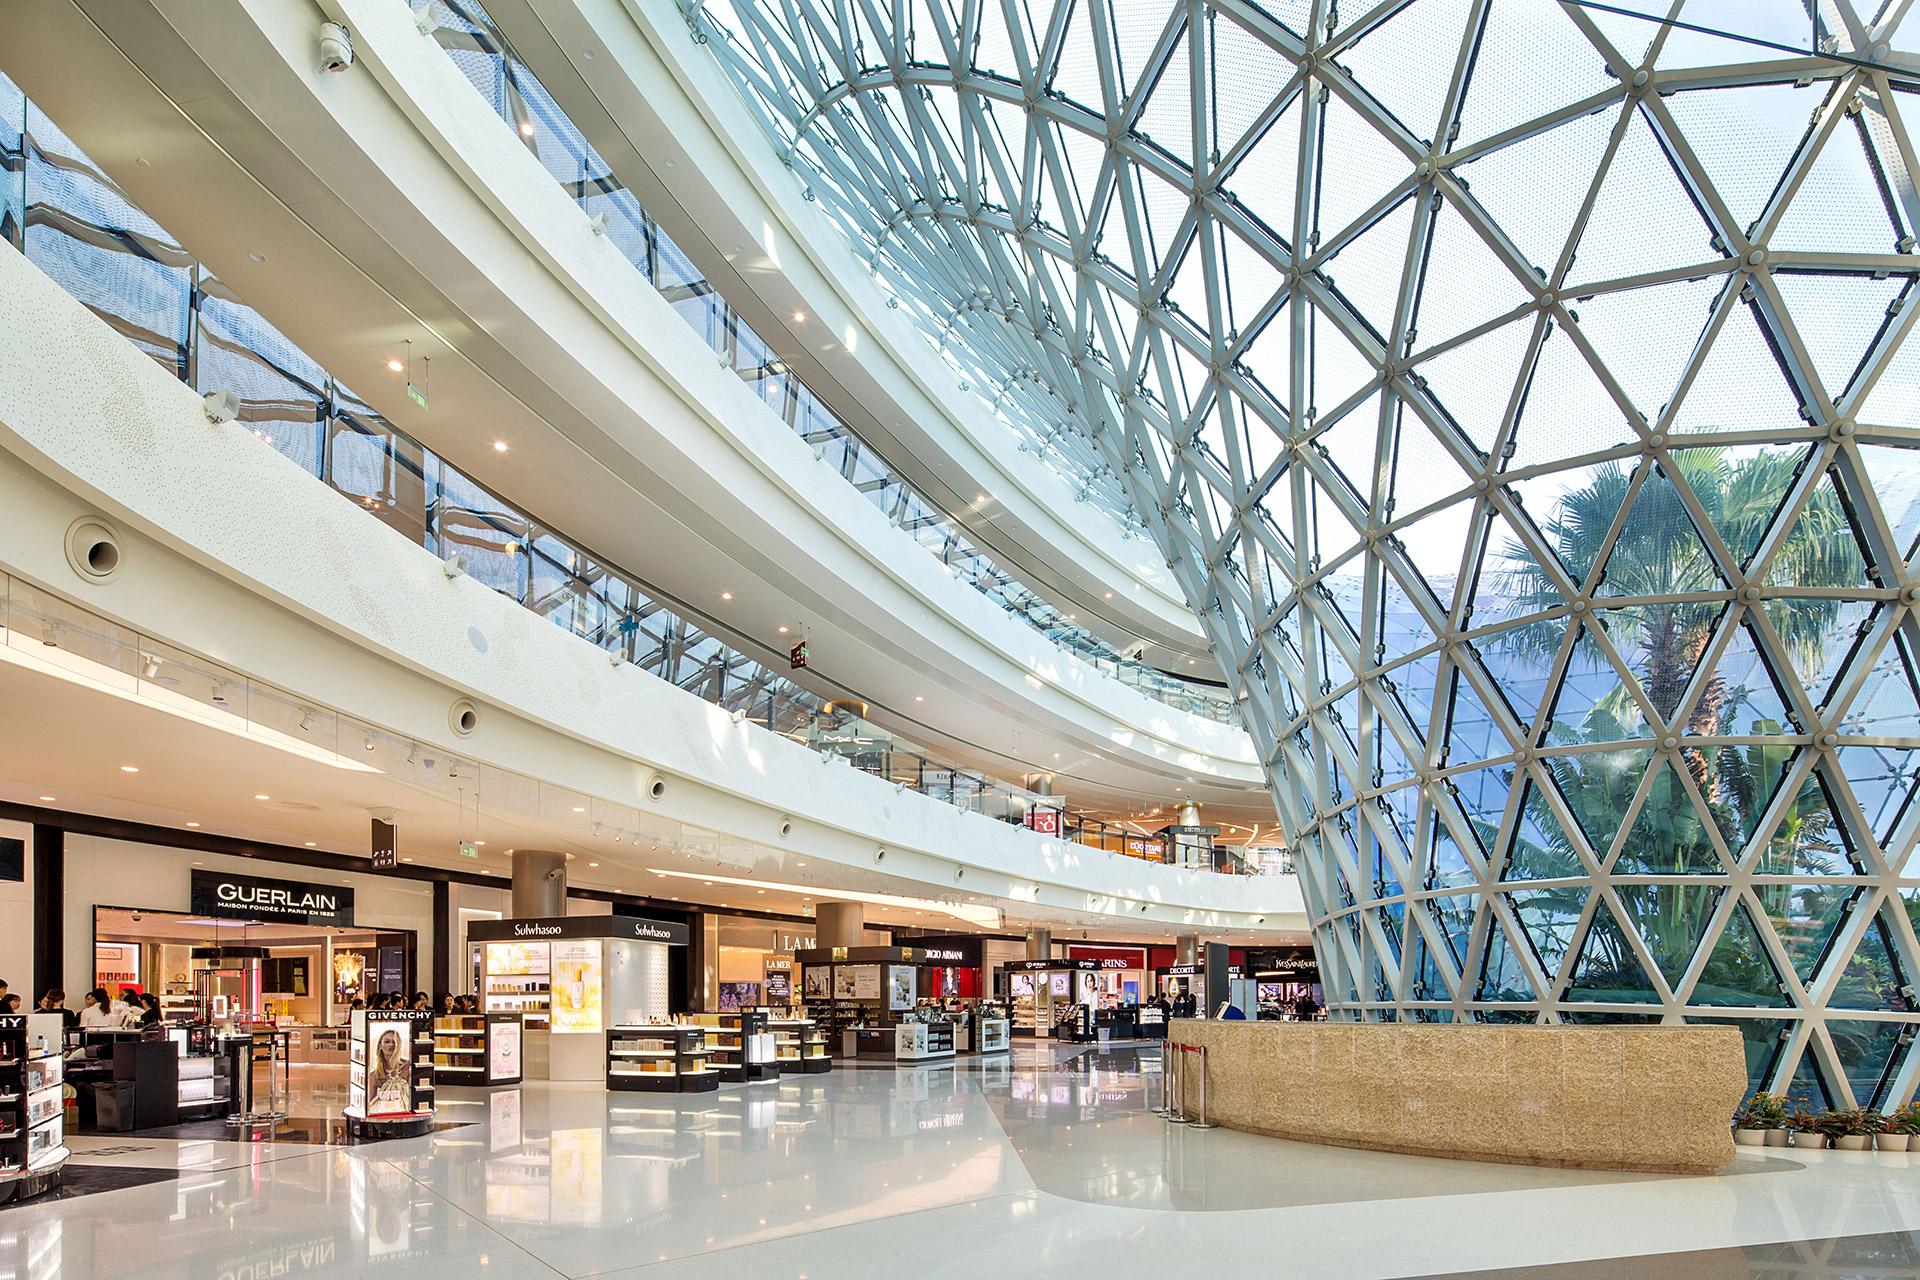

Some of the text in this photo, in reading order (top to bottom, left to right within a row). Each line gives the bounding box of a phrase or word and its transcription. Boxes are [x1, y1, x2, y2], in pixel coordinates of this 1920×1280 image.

[217, 883, 336, 910] GUERLAIN
[217, 902, 248, 910] MAISON
[249, 904, 279, 912] FONDÉE
[514, 923, 562, 936] Sulwhasoo
[634, 923, 671, 939] Sulwhasoo
[783, 935, 802, 951] LA
[766, 960, 791, 969] LA MER
[1169, 966, 1195, 974] DECORTÉ
[368, 1011, 432, 1020] GIVENCHY
